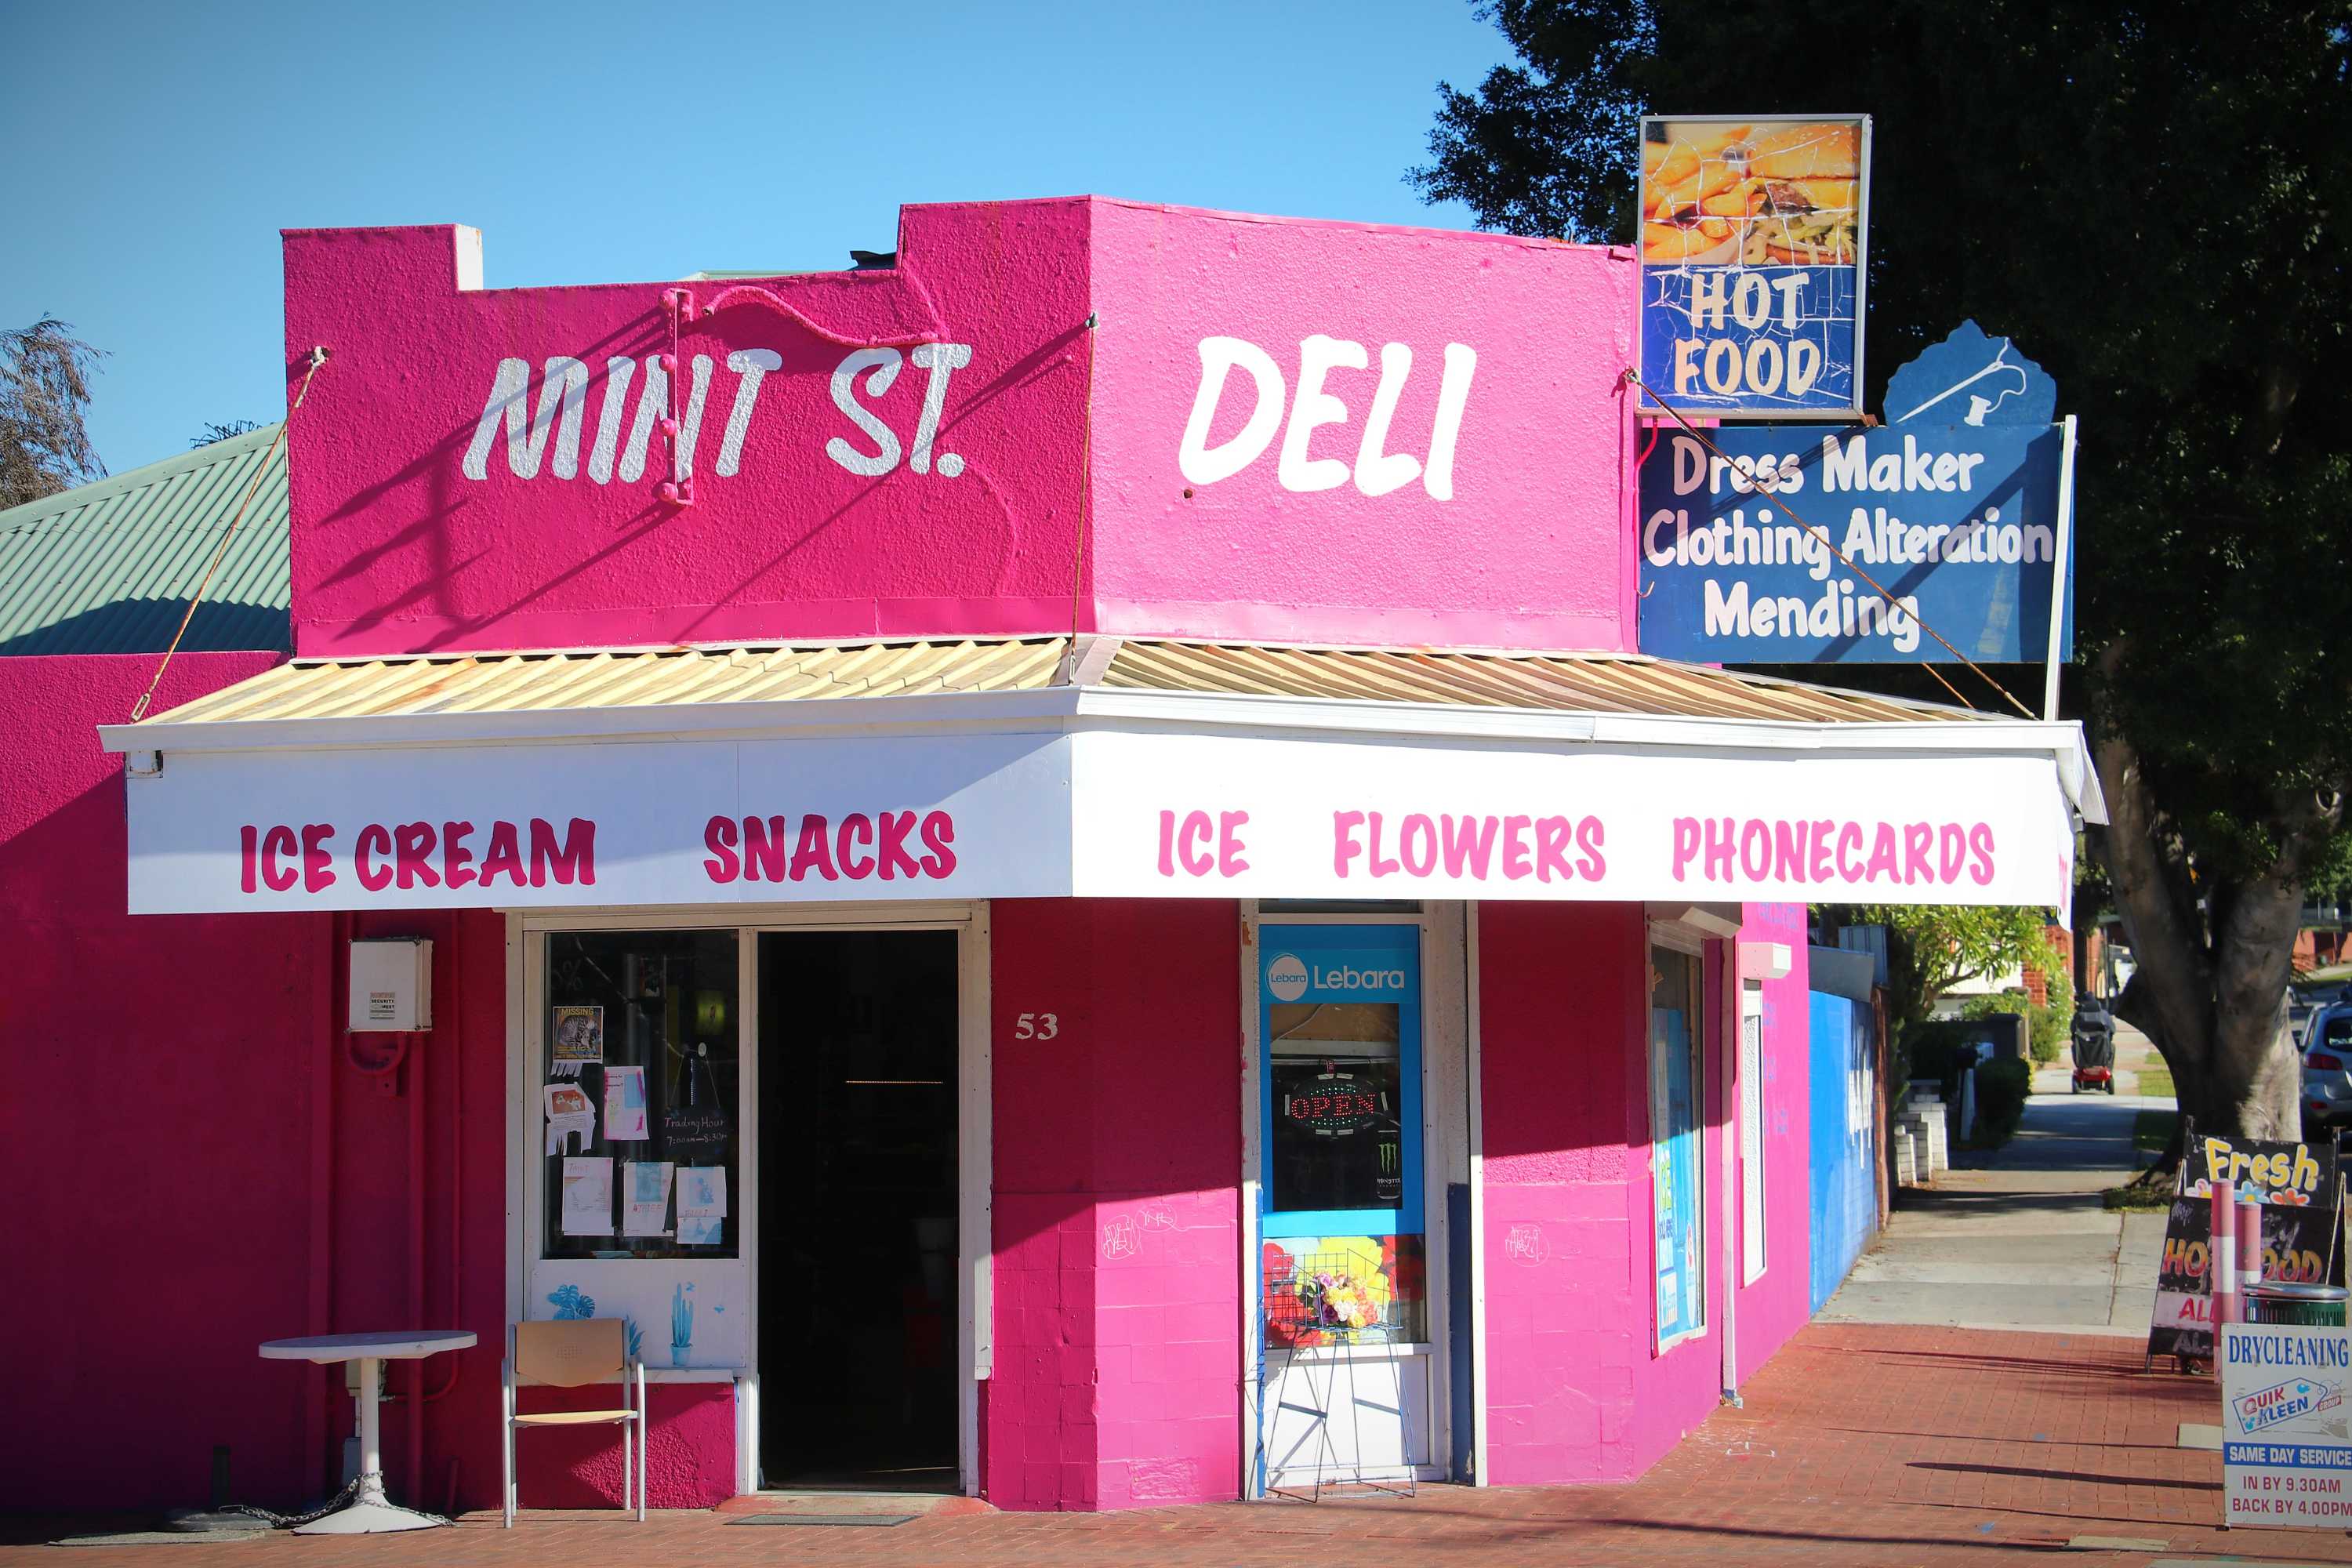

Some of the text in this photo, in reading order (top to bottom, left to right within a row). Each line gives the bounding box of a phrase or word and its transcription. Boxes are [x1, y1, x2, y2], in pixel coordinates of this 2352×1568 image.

[1691, 272, 1809, 330] HOT
[1675, 338, 1820, 395] FOOD
[462, 343, 972, 485] MINT ST.
[1179, 334, 1477, 501] DELI
[1672, 434, 1984, 495] Dress Maker
[1644, 506, 2053, 580] Clothing Alteration
[1704, 579, 1920, 652] Mending
[241, 818, 596, 893] ICE CREAM
[703, 810, 956, 884] SNACKS
[1158, 810, 1250, 877] ICE
[1333, 811, 1606, 883] FLOWERS
[1672, 817, 1994, 886] PHONECARDS
[1314, 965, 1404, 989] Lebara
[1015, 1013, 1058, 1040] 53
[1292, 1093, 1377, 1119] OPEN
[2205, 1138, 2319, 1191] Fresh
[2161, 1237, 2323, 1283] HO OOD
[2229, 1335, 2349, 1367] DRYCLEANING
[2244, 1387, 2285, 1415] QUIK
[2258, 1396, 2309, 1425] KLEEN
[2318, 1396, 2341, 1411] GROUP
[2230, 1446, 2352, 1465] SAME DAY SERVICE
[2233, 1498, 2352, 1516] BACK BY 4.00PM
[2243, 1475, 2340, 1493] IN BY 9.30AM
